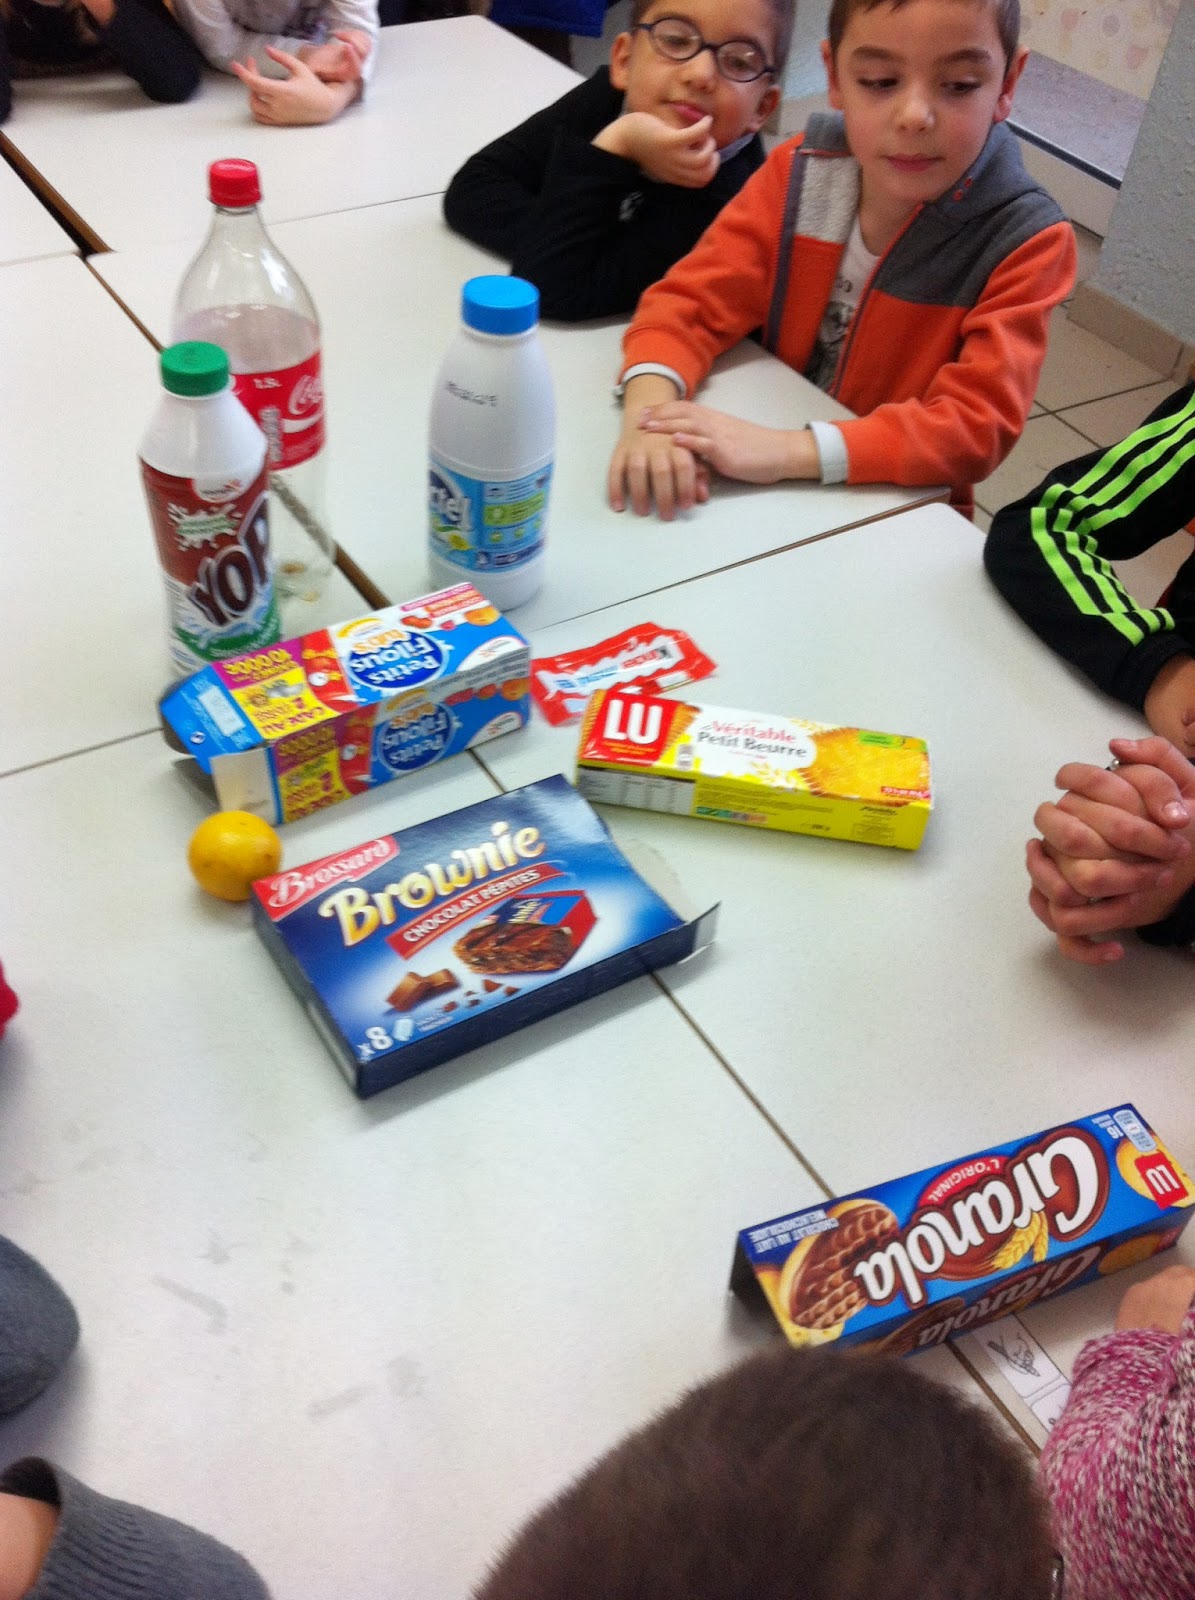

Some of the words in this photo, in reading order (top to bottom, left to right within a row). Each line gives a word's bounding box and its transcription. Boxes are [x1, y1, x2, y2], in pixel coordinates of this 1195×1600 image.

[350, 636, 435, 673] Filous
[366, 654, 442, 685] Petits
[602, 699, 663, 745] LU
[697, 730, 741, 751] Petit
[742, 734, 808, 759] Beurre
[710, 719, 797, 744] Véritable
[268, 838, 391, 908] Brossard
[318, 820, 546, 948] Brownie
[402, 893, 483, 943] CHOCOLAT
[1106, 1125, 1124, 1140] 16
[932, 1158, 1000, 1204] L'ORIGINAL
[1145, 1164, 1181, 1196] LU
[853, 1135, 1099, 1305] Granola
[918, 1244, 1101, 1347] Granola
